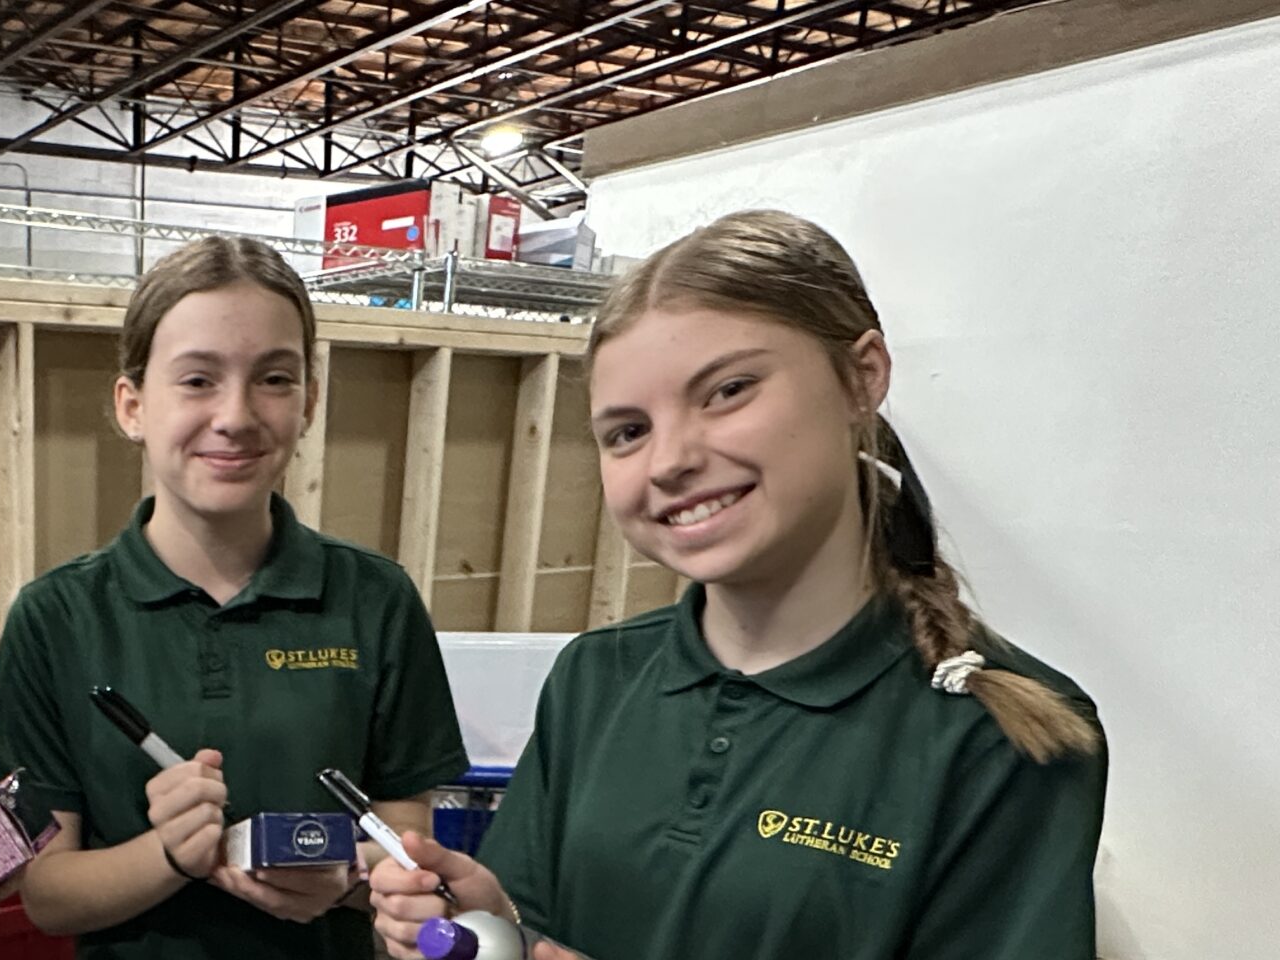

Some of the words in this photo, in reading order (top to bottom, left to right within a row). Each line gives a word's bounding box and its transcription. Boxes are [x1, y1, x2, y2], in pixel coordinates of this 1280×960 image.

[334, 224, 357, 243] 332
[782, 832, 846, 855] LUTHERAN
[849, 850, 893, 869] SCHOOL
